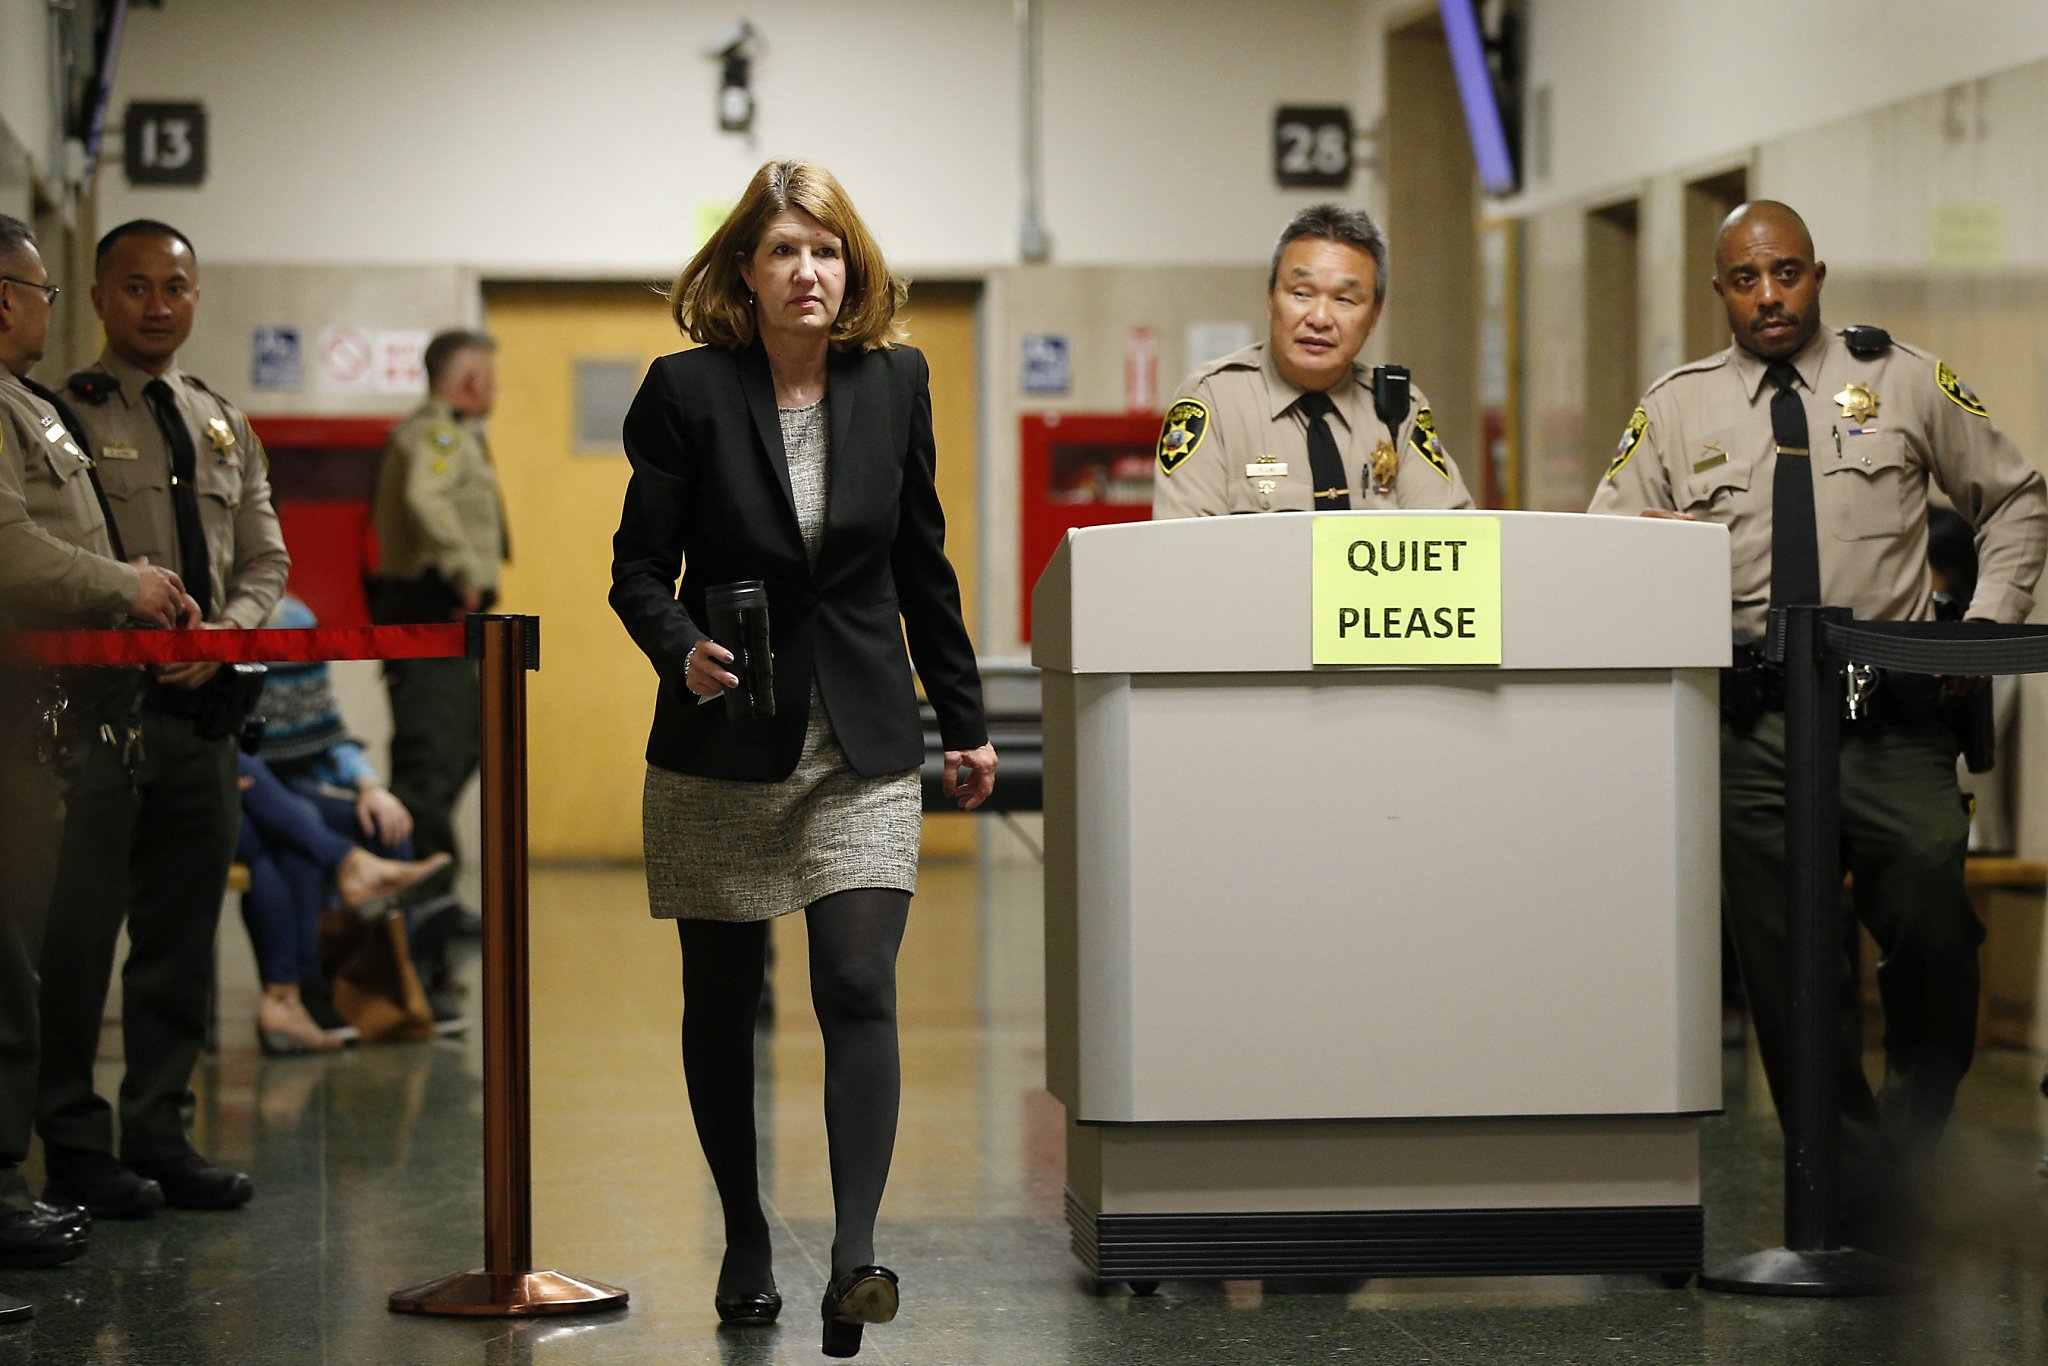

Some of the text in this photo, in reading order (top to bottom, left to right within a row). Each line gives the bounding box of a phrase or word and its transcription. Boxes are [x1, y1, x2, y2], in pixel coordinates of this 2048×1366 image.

[142, 120, 192, 168] 13
[1279, 123, 1344, 173] 28
[1347, 540, 1467, 577] QUIET
[1339, 607, 1476, 639] PLEASE
